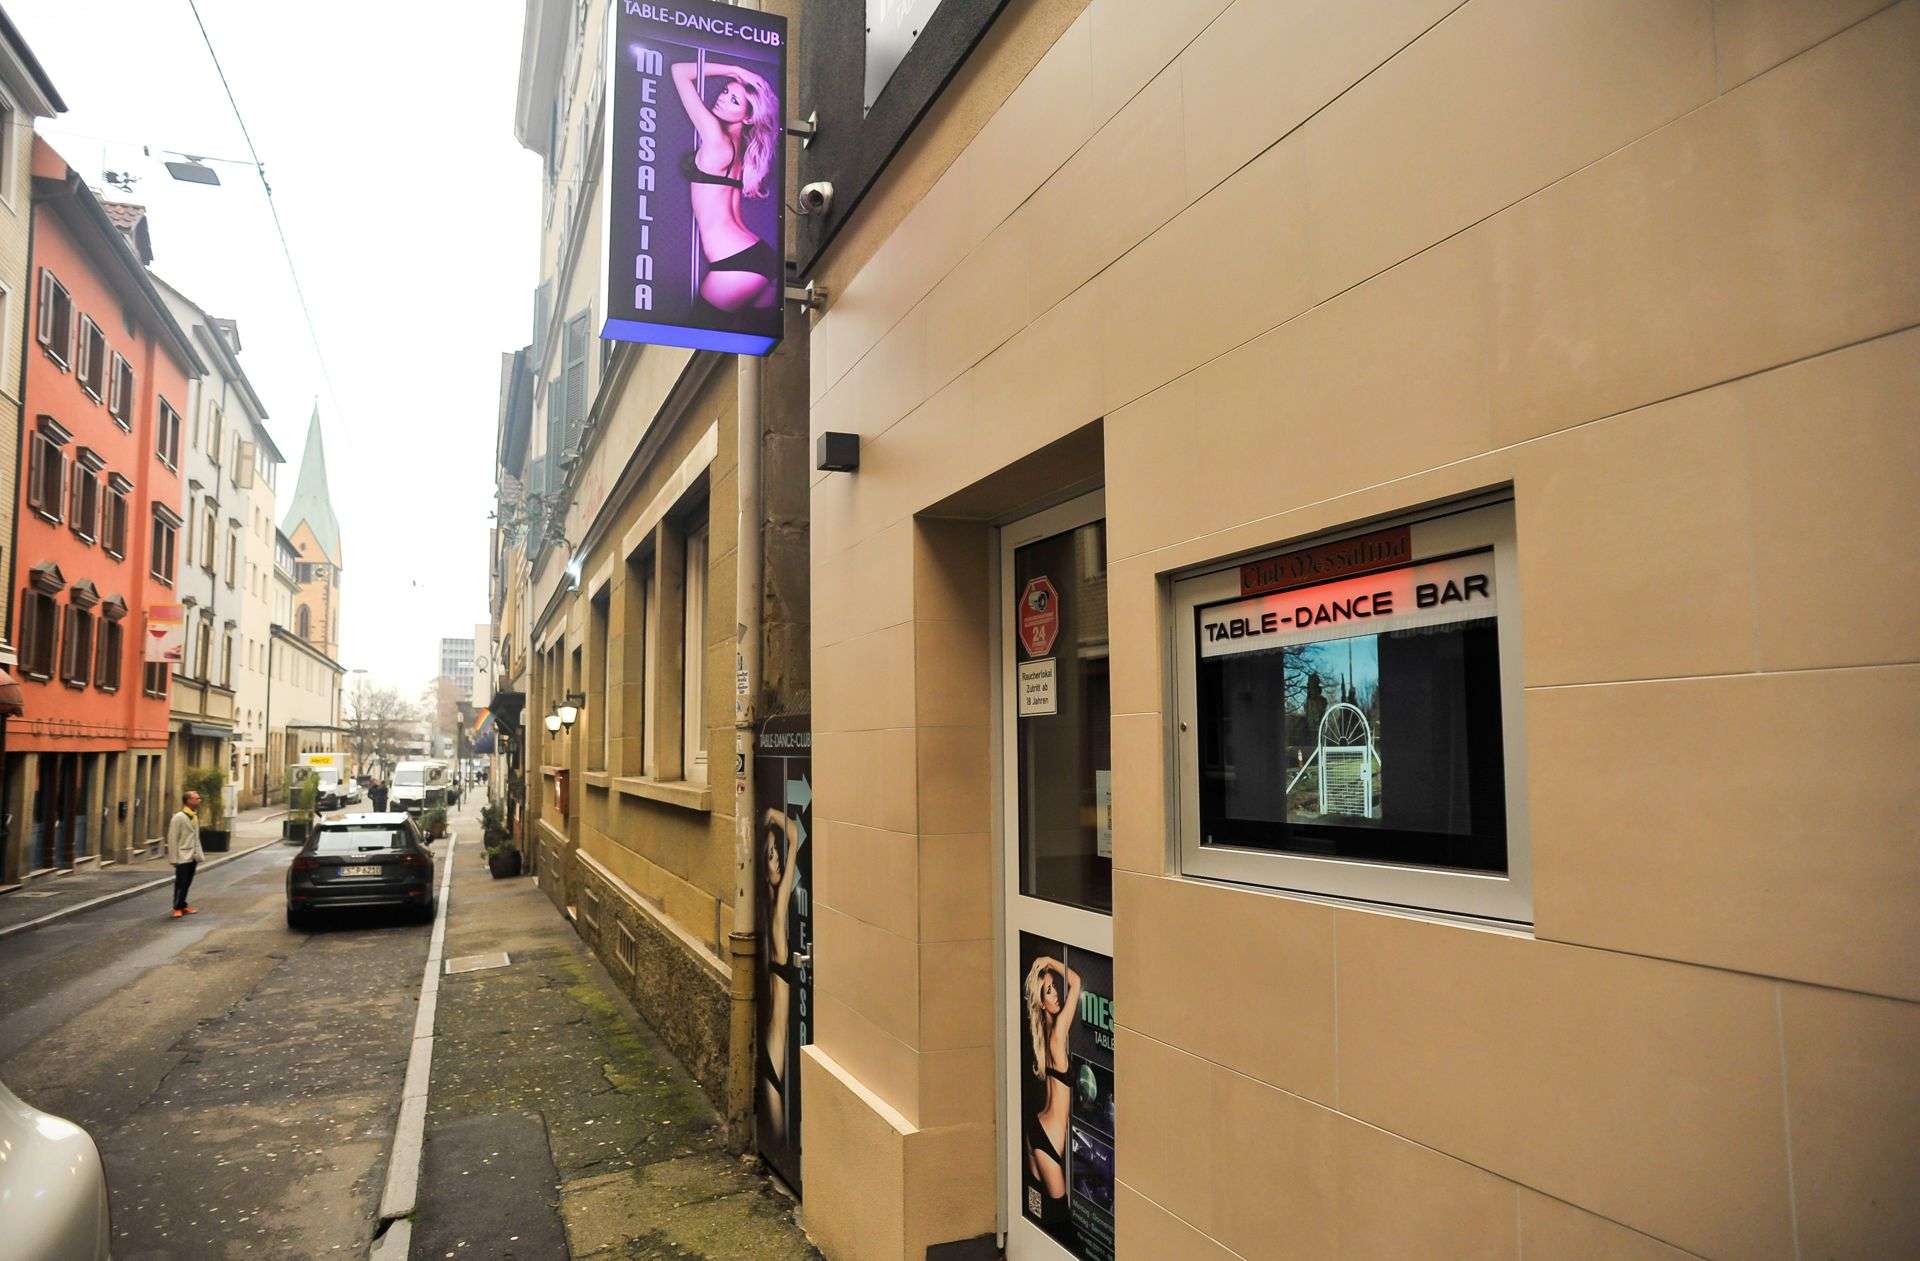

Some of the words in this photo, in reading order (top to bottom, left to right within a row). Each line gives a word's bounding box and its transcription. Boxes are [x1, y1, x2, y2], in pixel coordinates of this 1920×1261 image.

[624, 0, 780, 46] TABLE-DANCE-CLUB
[634, 48, 663, 311] MESSALINA
[1204, 591, 1393, 642] TABLE-DANCE
[1415, 574, 1490, 609] BAR
